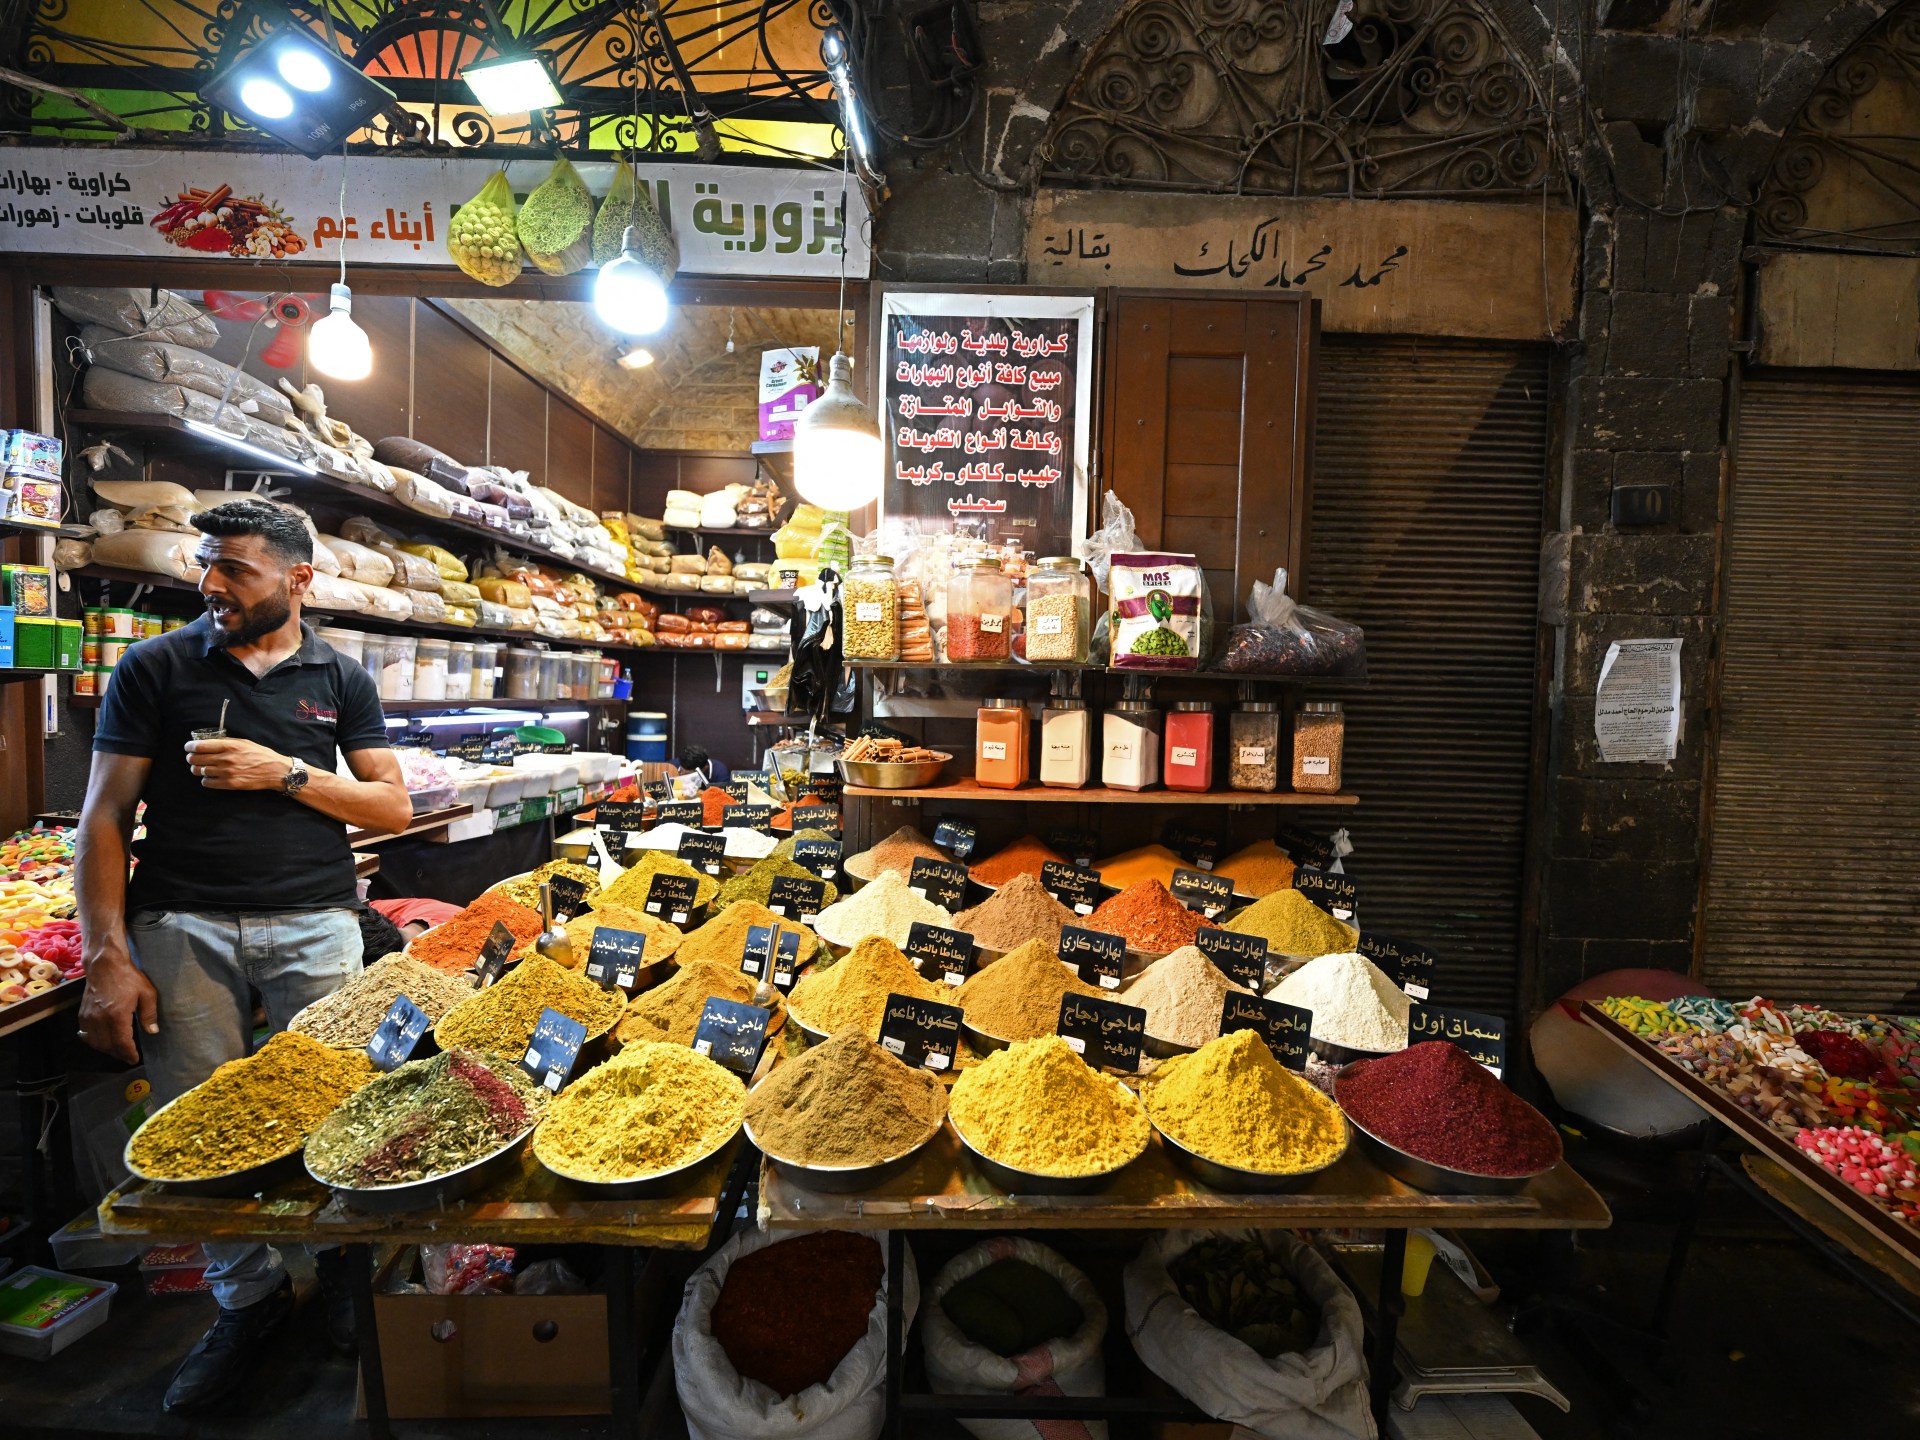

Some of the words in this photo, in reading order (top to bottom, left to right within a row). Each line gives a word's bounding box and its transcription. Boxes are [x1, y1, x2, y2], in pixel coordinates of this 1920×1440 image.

[348, 97, 367, 112] IP66
[307, 122, 331, 142] 100W
[0, 171, 51, 197] بهارا
[68, 171, 131, 198] كراوية
[0, 203, 59, 229] زهورا
[76, 201, 144, 227] قلوبات
[370, 201, 435, 242] أبناء
[312, 214, 359, 248] عم
[1043, 227, 1112, 270] بقالية
[1264, 243, 1334, 288] محمد
[1339, 244, 1409, 288] محمد
[896, 328, 958, 354] ولوازمها
[960, 328, 1009, 357] بلدية
[1011, 330, 1069, 358] كراوية
[896, 361, 953, 387] البهارات
[956, 361, 993, 388] أنواع
[995, 363, 1026, 385] كافة
[1029, 371, 1062, 391] مبيع
[898, 394, 972, 418] الممتازة
[977, 396, 1062, 423] والتوابل
[896, 426, 961, 453] القلوبات
[963, 427, 1007, 453] أنواع
[1010, 428, 1062, 455] وكافة
[896, 460, 943, 484] كريما
[955, 462, 1005, 486] كاكاو
[1018, 467, 1062, 488] حليب
[947, 493, 1007, 515] سحلب
[1142, 571, 1170, 581] MAS
[598, 804, 622, 816] حبيبات
[621, 805, 642, 818] ماجي
[658, 806, 676, 820] فطر
[724, 807, 746, 821] خضار
[793, 809, 818, 823] ملوخية
[817, 808, 838, 821] بهارات
[680, 837, 703, 851] محاشي
[703, 840, 724, 854] بهارات
[817, 845, 838, 859] بهارات
[912, 865, 942, 880] أندومي
[941, 868, 965, 887] بهارات
[1044, 864, 1075, 880] بهارات
[1175, 875, 1200, 889] شيش
[1295, 873, 1323, 889] فلافل
[661, 878, 688, 890] بهارات
[783, 881, 812, 894] بهارات
[1051, 877, 1085, 893] مشكلة
[1200, 880, 1229, 898] بهارات
[1324, 879, 1355, 898] بهارات
[667, 890, 693, 903] بطاطا
[771, 891, 792, 901] ناعم
[793, 895, 819, 905] مندي
[592, 934, 618, 954] خليجية
[927, 929, 955, 946] بهارات
[1062, 934, 1091, 953] كاري
[1198, 932, 1231, 953] شاورما
[1360, 937, 1399, 958] خاروف
[617, 938, 641, 959] كبسة
[909, 940, 938, 958] بالفرن
[939, 946, 966, 964] بطاطا
[1091, 939, 1122, 963] بهارات
[1232, 939, 1264, 962] بهارات
[615, 963, 636, 975] الوقية
[938, 960, 964, 974] الوقية
[1400, 952, 1433, 967] ماجي
[1093, 964, 1119, 977] الوقية
[1232, 964, 1260, 978] الوقية
[887, 1004, 916, 1023] ناعم
[916, 1009, 959, 1031] كمون
[1063, 1002, 1099, 1027] دجاج
[1226, 999, 1267, 1021] خضار
[736, 1016, 764, 1036] ماجي
[1101, 1014, 1142, 1036] ماجي
[1268, 1014, 1307, 1036] ماجي
[1412, 1011, 1446, 1035] أول
[1446, 1018, 1501, 1041] سماق
[729, 1042, 756, 1057] الوقية
[922, 1040, 952, 1055] الوقية
[1103, 1040, 1136, 1057] الوقية
[1269, 1039, 1303, 1056] الوقية
